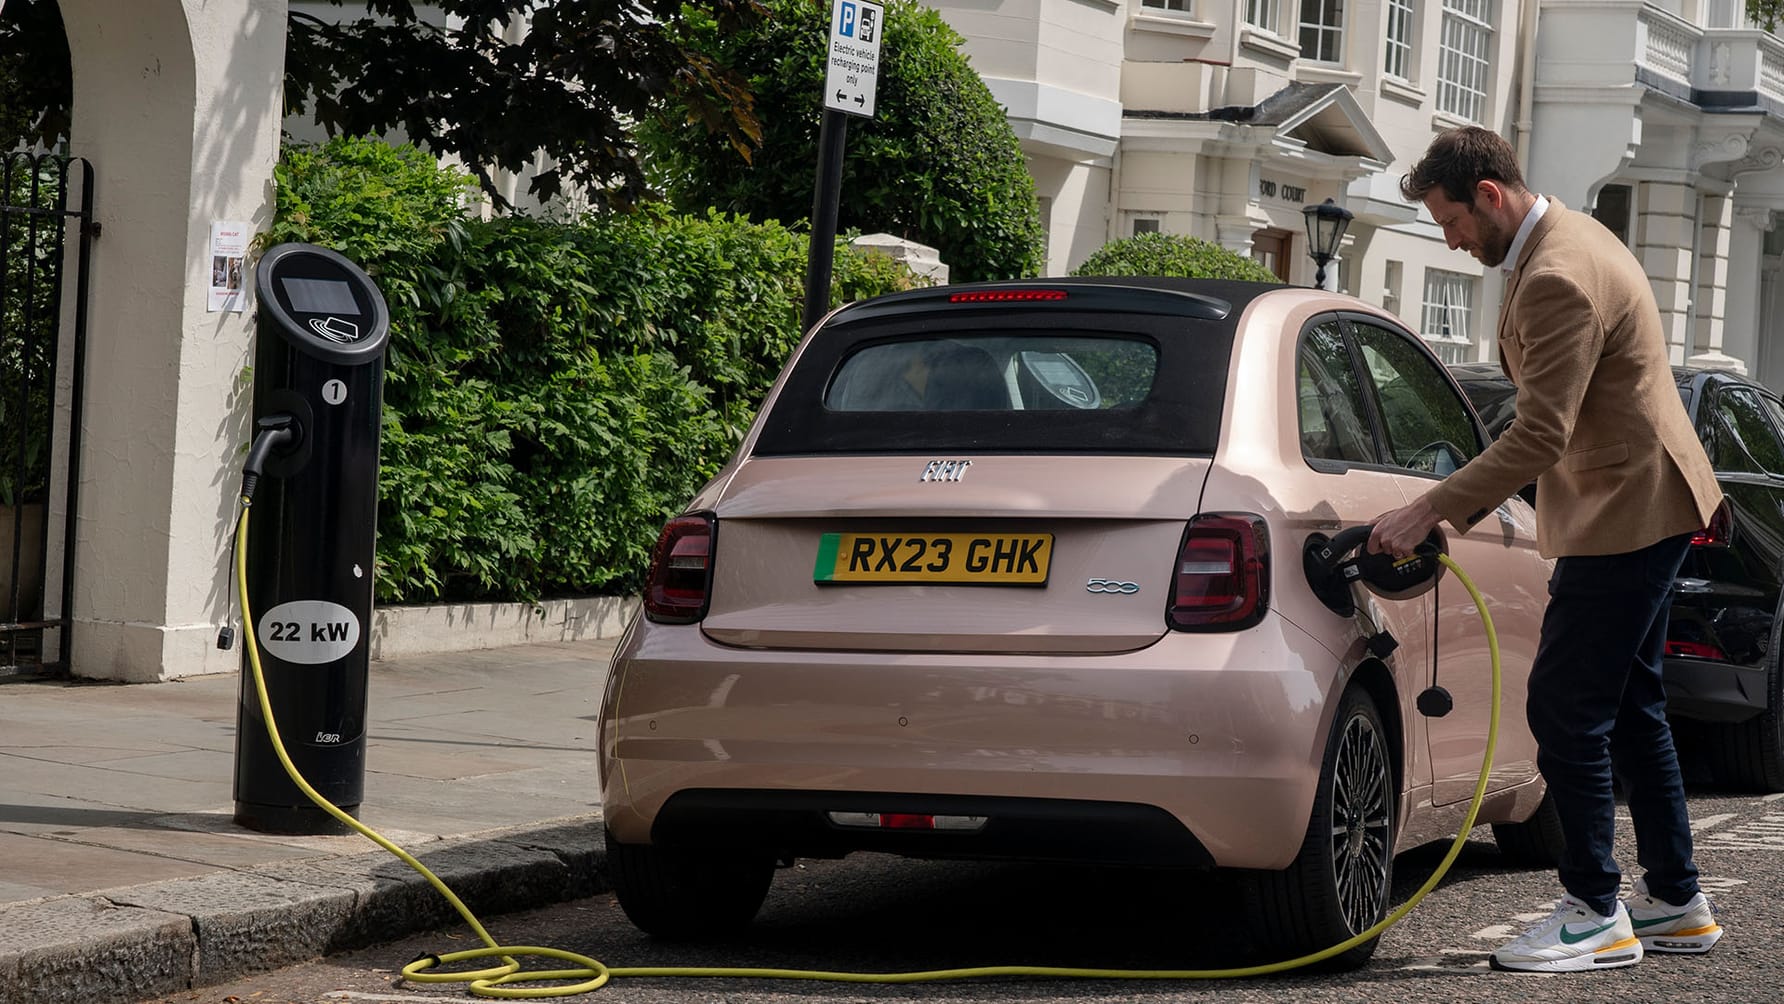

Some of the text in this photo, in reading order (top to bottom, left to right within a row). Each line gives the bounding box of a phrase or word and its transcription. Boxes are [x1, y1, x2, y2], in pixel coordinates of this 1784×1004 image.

[843, 6, 853, 33] P
[834, 41, 875, 61] Electric vehicle
[831, 57, 875, 75] recharging point
[846, 74, 858, 87] only
[1281, 184, 1306, 203] COURT
[331, 382, 339, 400] 1
[920, 460, 973, 482] FIAT
[849, 537, 1044, 573] RX23 GHK
[269, 621, 350, 642] 22 kW
